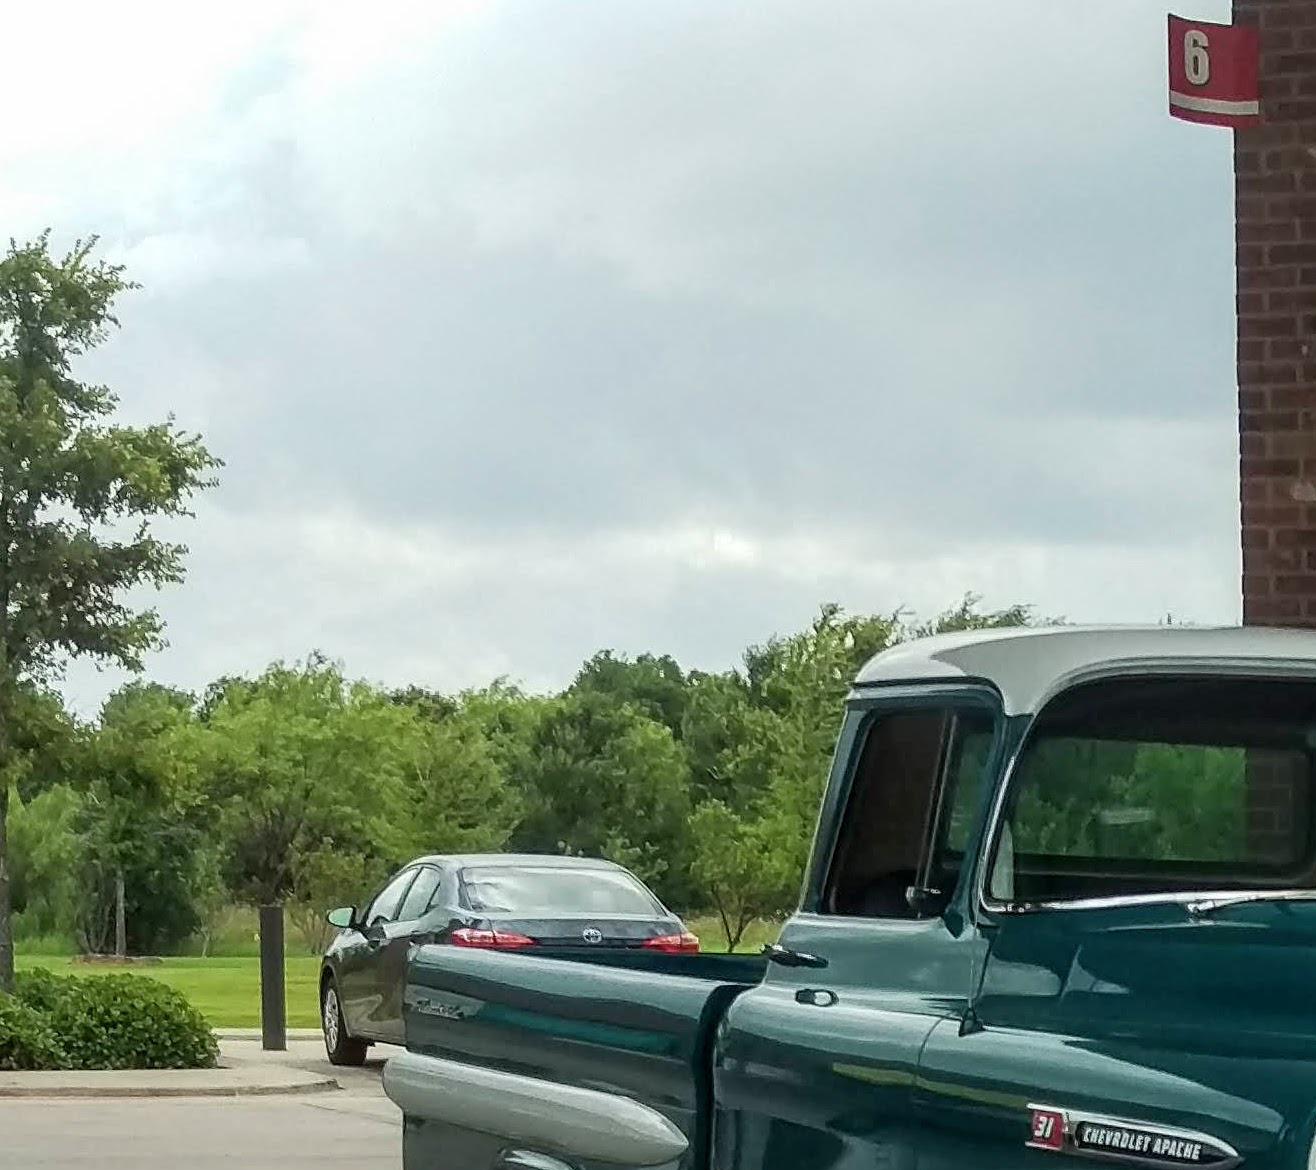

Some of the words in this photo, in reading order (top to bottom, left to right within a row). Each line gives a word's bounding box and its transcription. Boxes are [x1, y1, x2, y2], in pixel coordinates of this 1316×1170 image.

[1183, 30, 1210, 85] 6
[1082, 1126, 1151, 1152] CHEVROLET
[1152, 1138, 1202, 1160] APACHE
